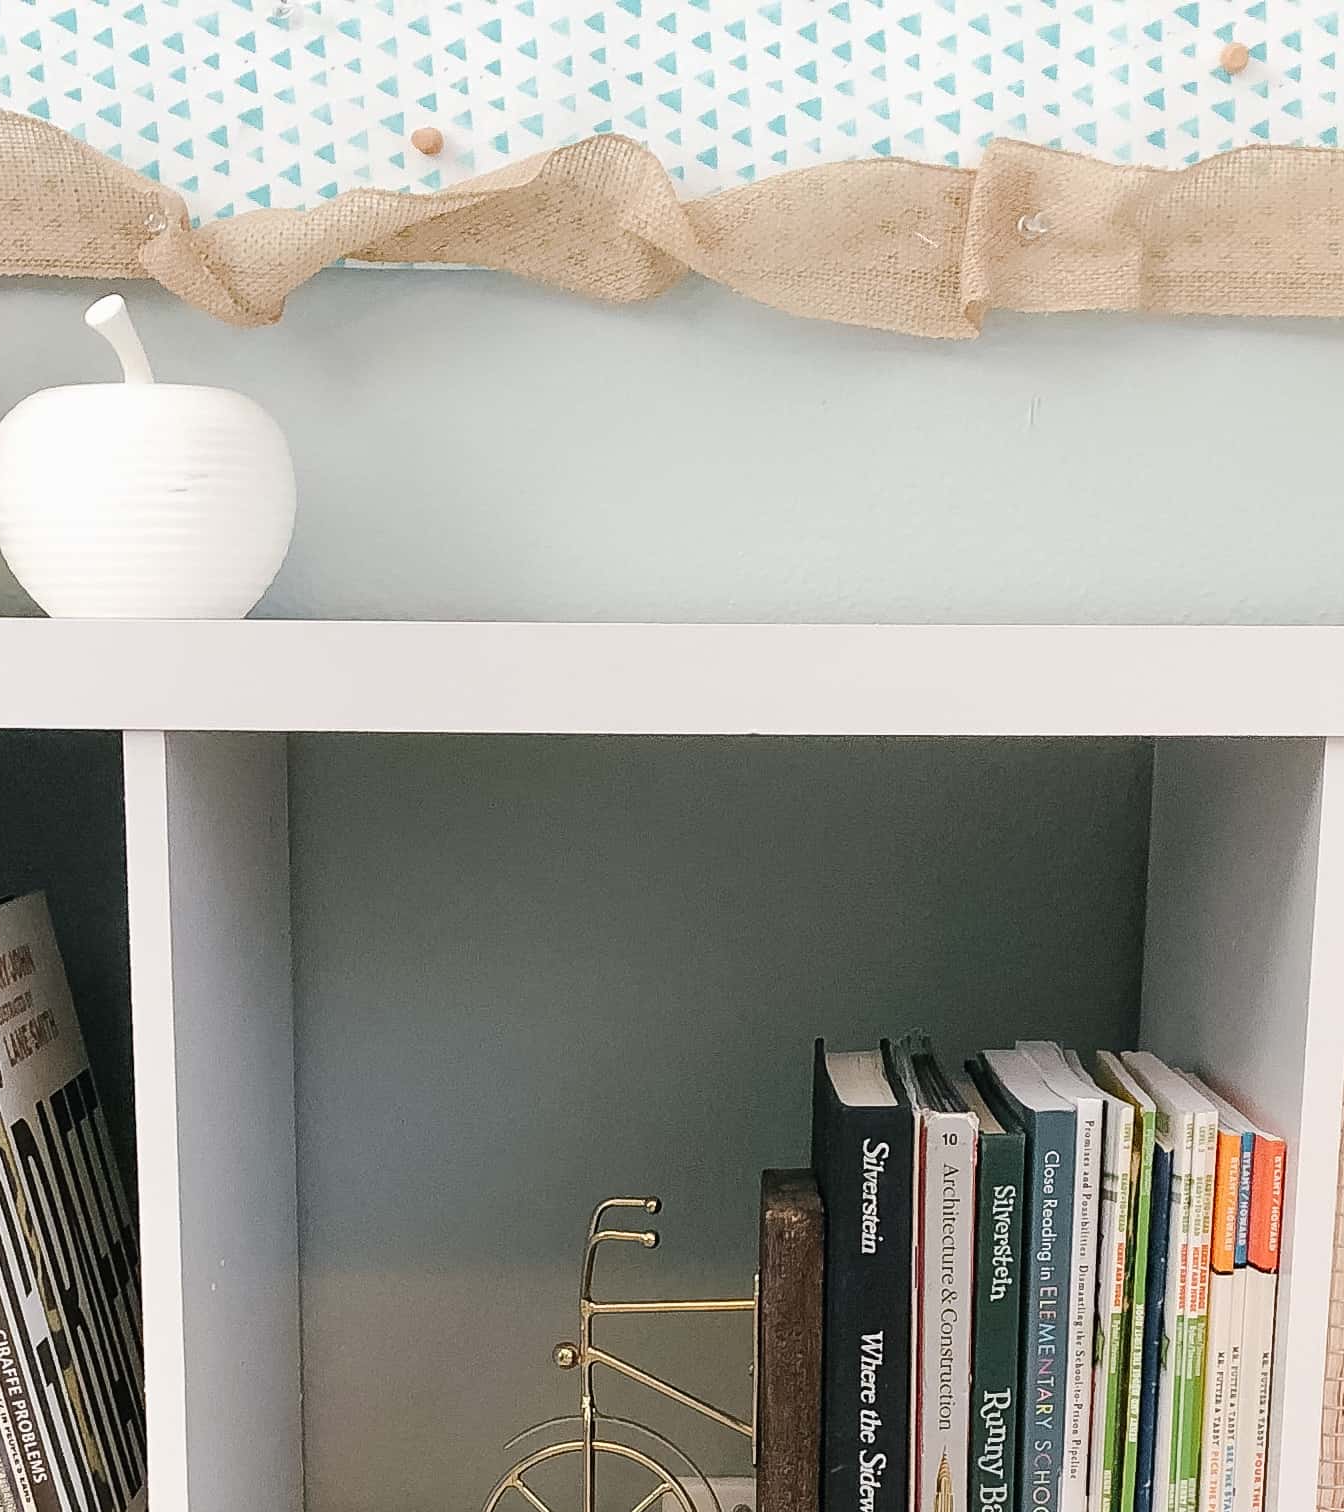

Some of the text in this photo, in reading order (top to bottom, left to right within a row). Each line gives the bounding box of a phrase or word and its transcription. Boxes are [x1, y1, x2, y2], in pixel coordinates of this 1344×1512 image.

[1042, 1151, 1059, 1194] Close
[1082, 1120, 1094, 1167] Promises
[860, 1138, 889, 1253] Silverstein
[1082, 1171, 1092, 1188] and
[989, 1185, 1015, 1301] Silverstein
[1036, 1199, 1057, 1261] Reading
[938, 1163, 960, 1431] Architecture & Construction
[1040, 1266, 1055, 1281] in
[1074, 1265, 1088, 1327] Dismantling
[859, 1331, 883, 1403] Where
[1036, 1286, 1056, 1429] ELEMENTARY
[1075, 1330, 1084, 1346] the
[1072, 1350, 1085, 1436] School-to-Prison
[6, 1400, 48, 1483] PROBLEMS
[860, 1410, 883, 1444] the
[978, 1388, 1010, 1479] Runny
[1069, 1439, 1082, 1479] Pipeline
